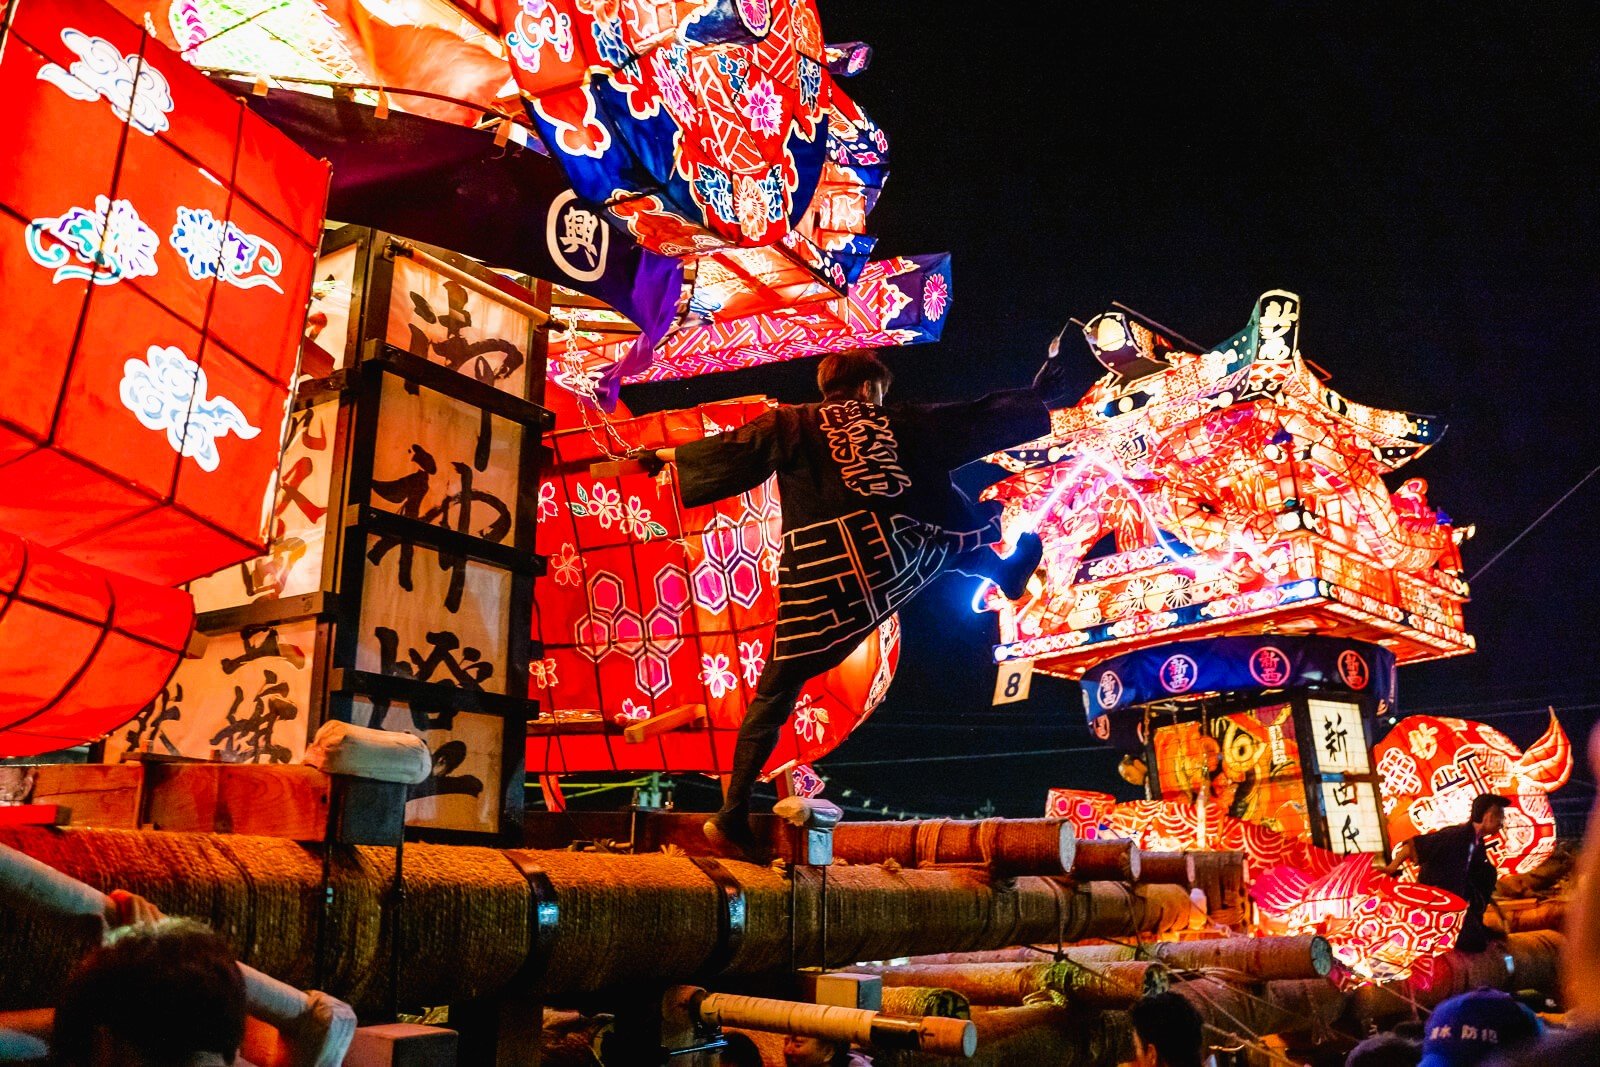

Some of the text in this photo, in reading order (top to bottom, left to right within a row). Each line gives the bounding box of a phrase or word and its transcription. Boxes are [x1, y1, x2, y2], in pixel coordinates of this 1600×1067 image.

[557, 204, 602, 269] 興
[1167, 657, 1190, 690] 新西
[1258, 649, 1284, 683] 新西
[1344, 653, 1364, 687] 新西
[1004, 672, 1022, 698] 8
[1100, 673, 1118, 707] 新西
